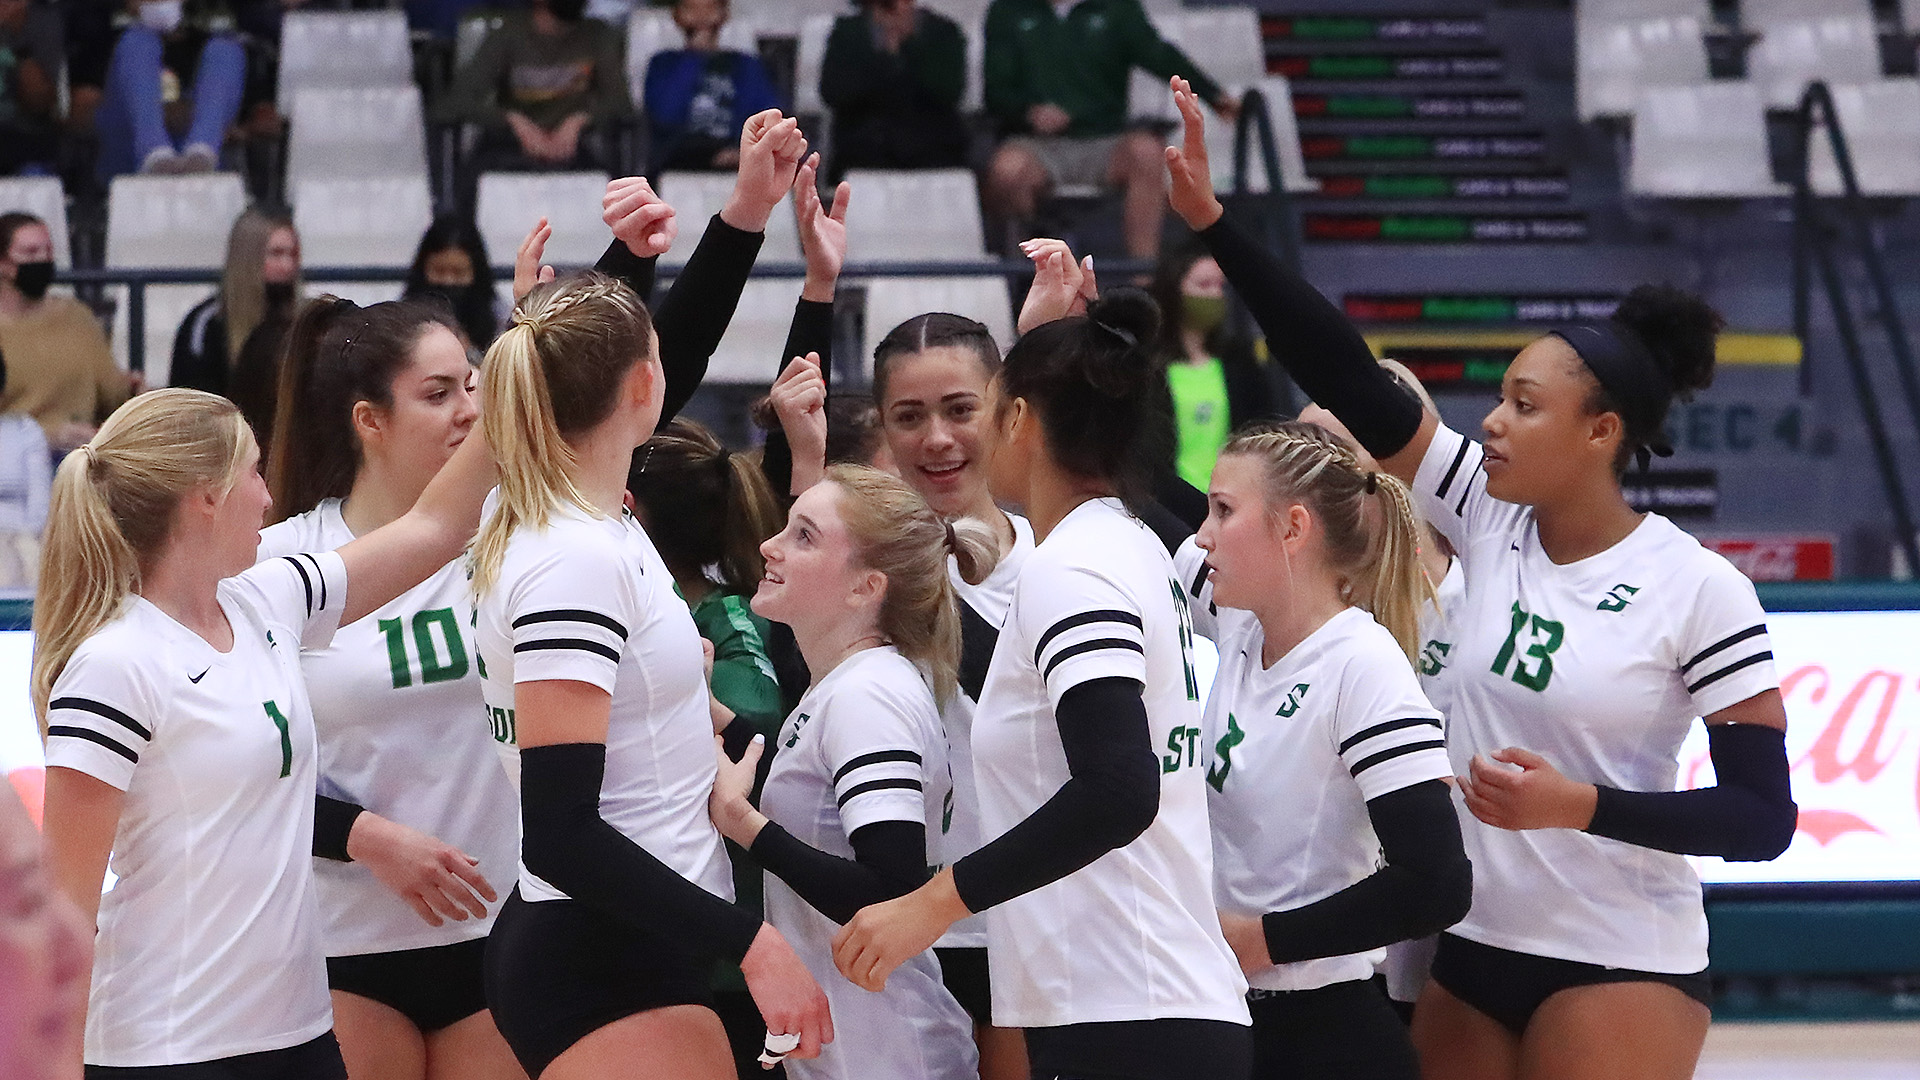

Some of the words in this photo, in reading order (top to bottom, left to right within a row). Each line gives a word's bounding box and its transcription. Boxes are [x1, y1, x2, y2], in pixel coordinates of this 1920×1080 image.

[378, 606, 471, 689] 10
[1490, 599, 1565, 693] 13
[262, 699, 292, 779] 1
[1162, 723, 1204, 775] ST
